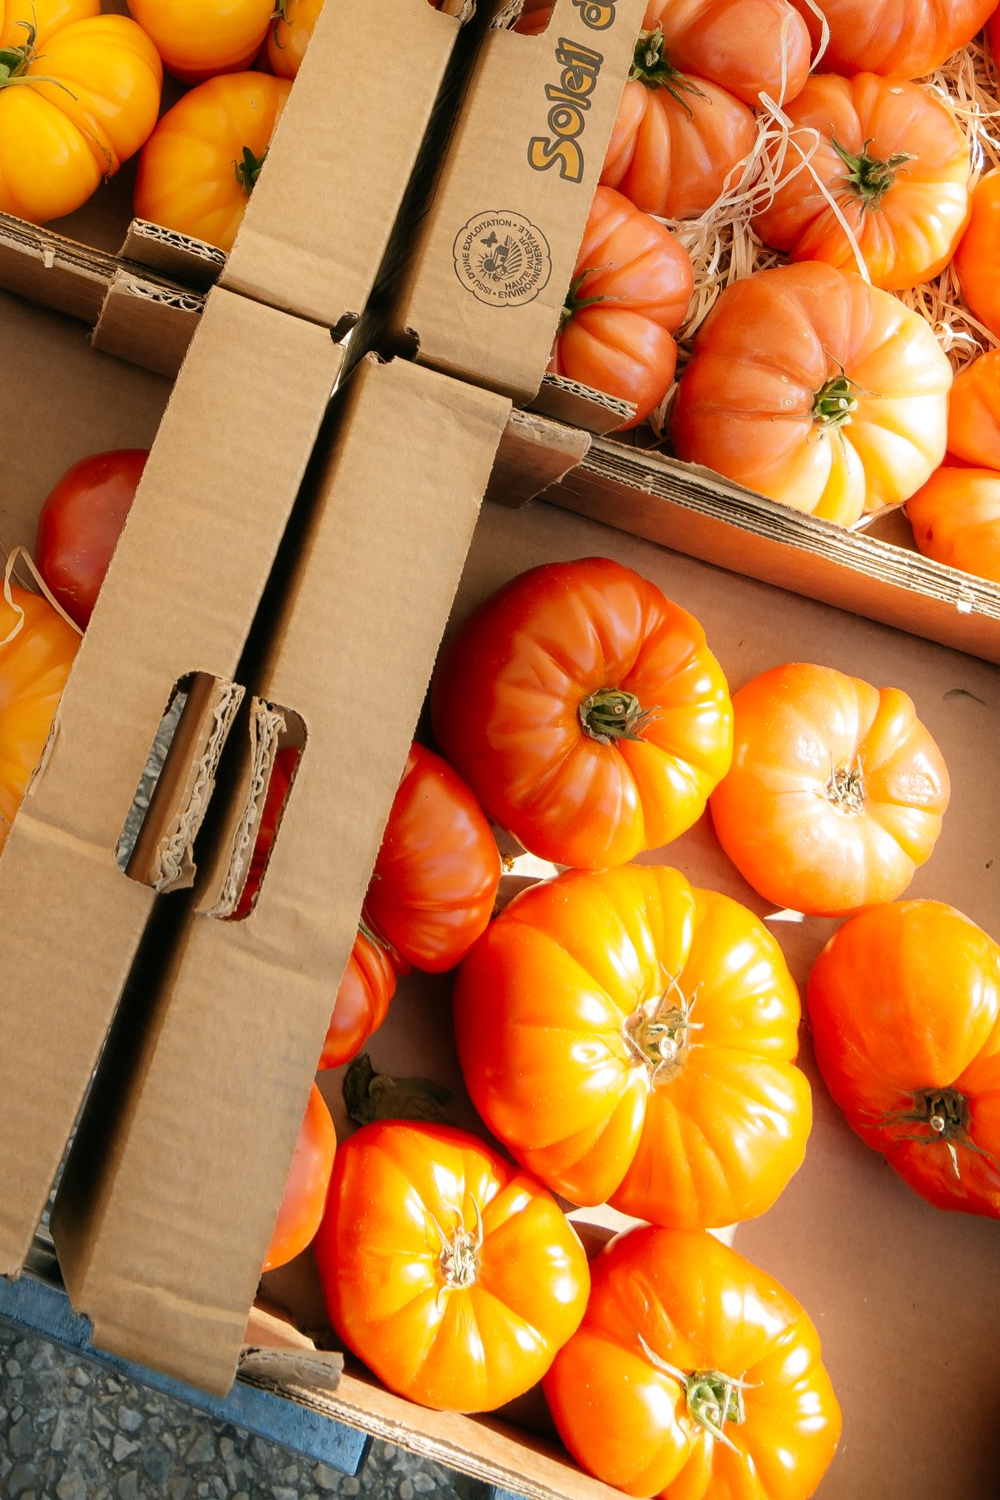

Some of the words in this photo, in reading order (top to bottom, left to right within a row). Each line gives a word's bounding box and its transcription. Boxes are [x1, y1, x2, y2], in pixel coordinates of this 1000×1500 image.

[527, 37, 604, 183] Soleil
[462, 218, 512, 252] EXPLOITATION
[462, 252, 476, 280] D'UNE
[498, 224, 543, 299] ENVIRONNEMENTALE
[504, 271, 531, 291] HAUTE
[518, 236, 535, 271] VALEUR
[472, 279, 492, 296] ISSU
